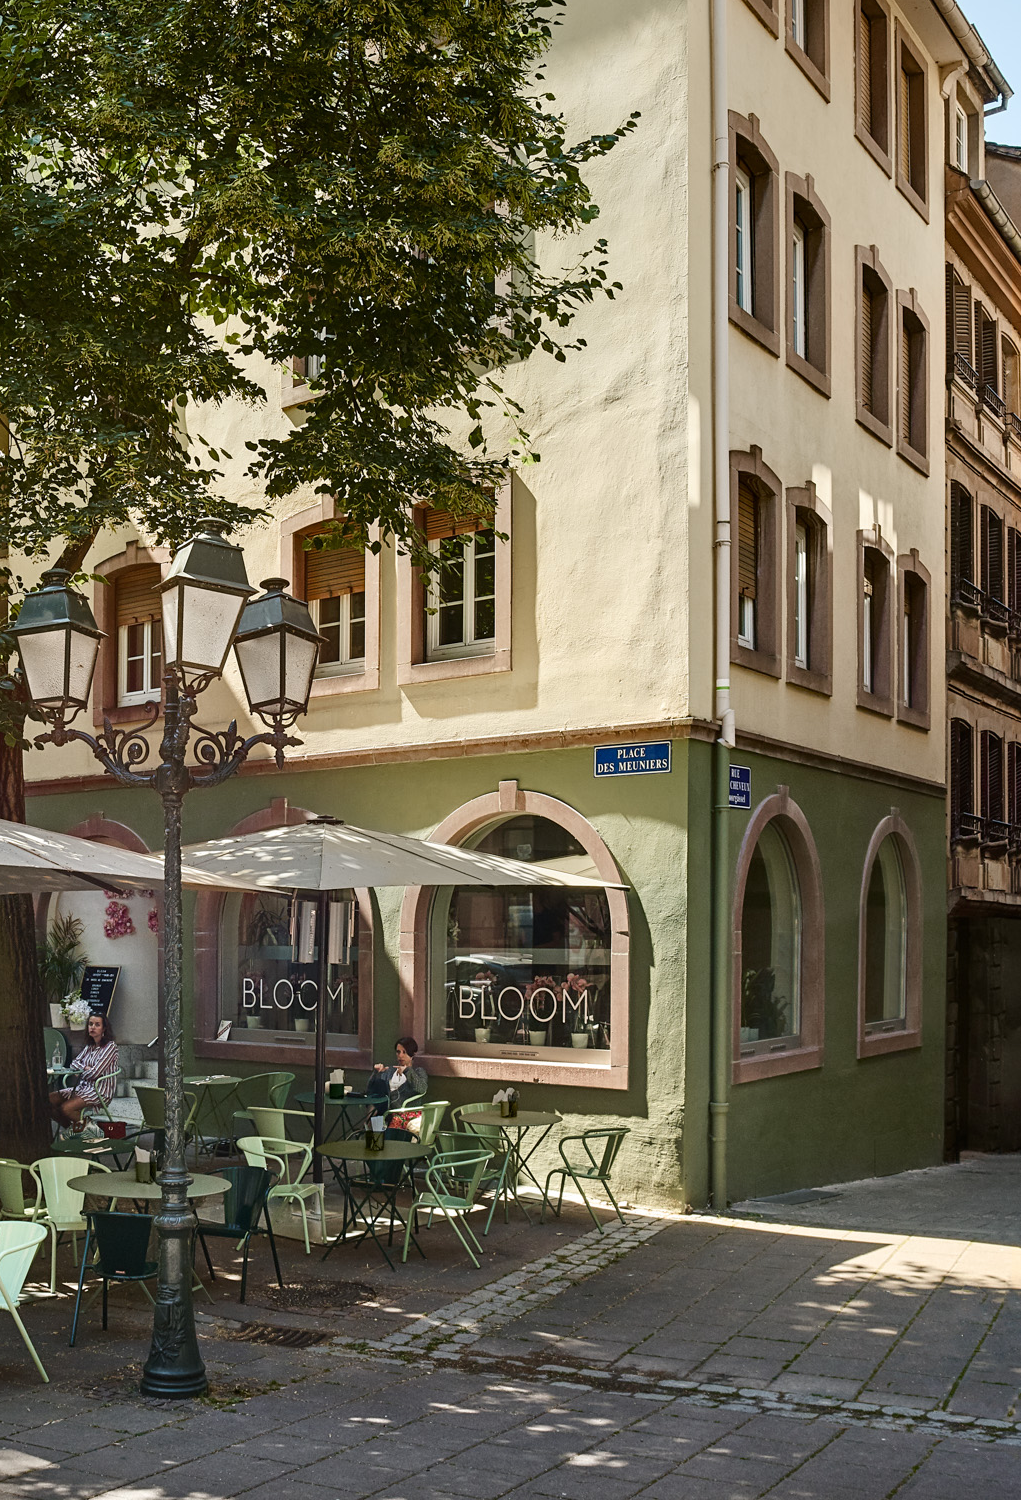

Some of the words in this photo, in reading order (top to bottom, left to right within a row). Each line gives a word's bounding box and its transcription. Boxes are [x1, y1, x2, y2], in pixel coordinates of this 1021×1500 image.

[617, 747, 646, 759] PLACE
[597, 762, 615, 773] DES
[618, 758, 668, 772] MEUNIERS
[731, 768, 740, 778] RUE
[729, 780, 750, 791] CHEVEUX
[243, 978, 344, 1012] BLOOM
[459, 985, 588, 1024] BLOOM
